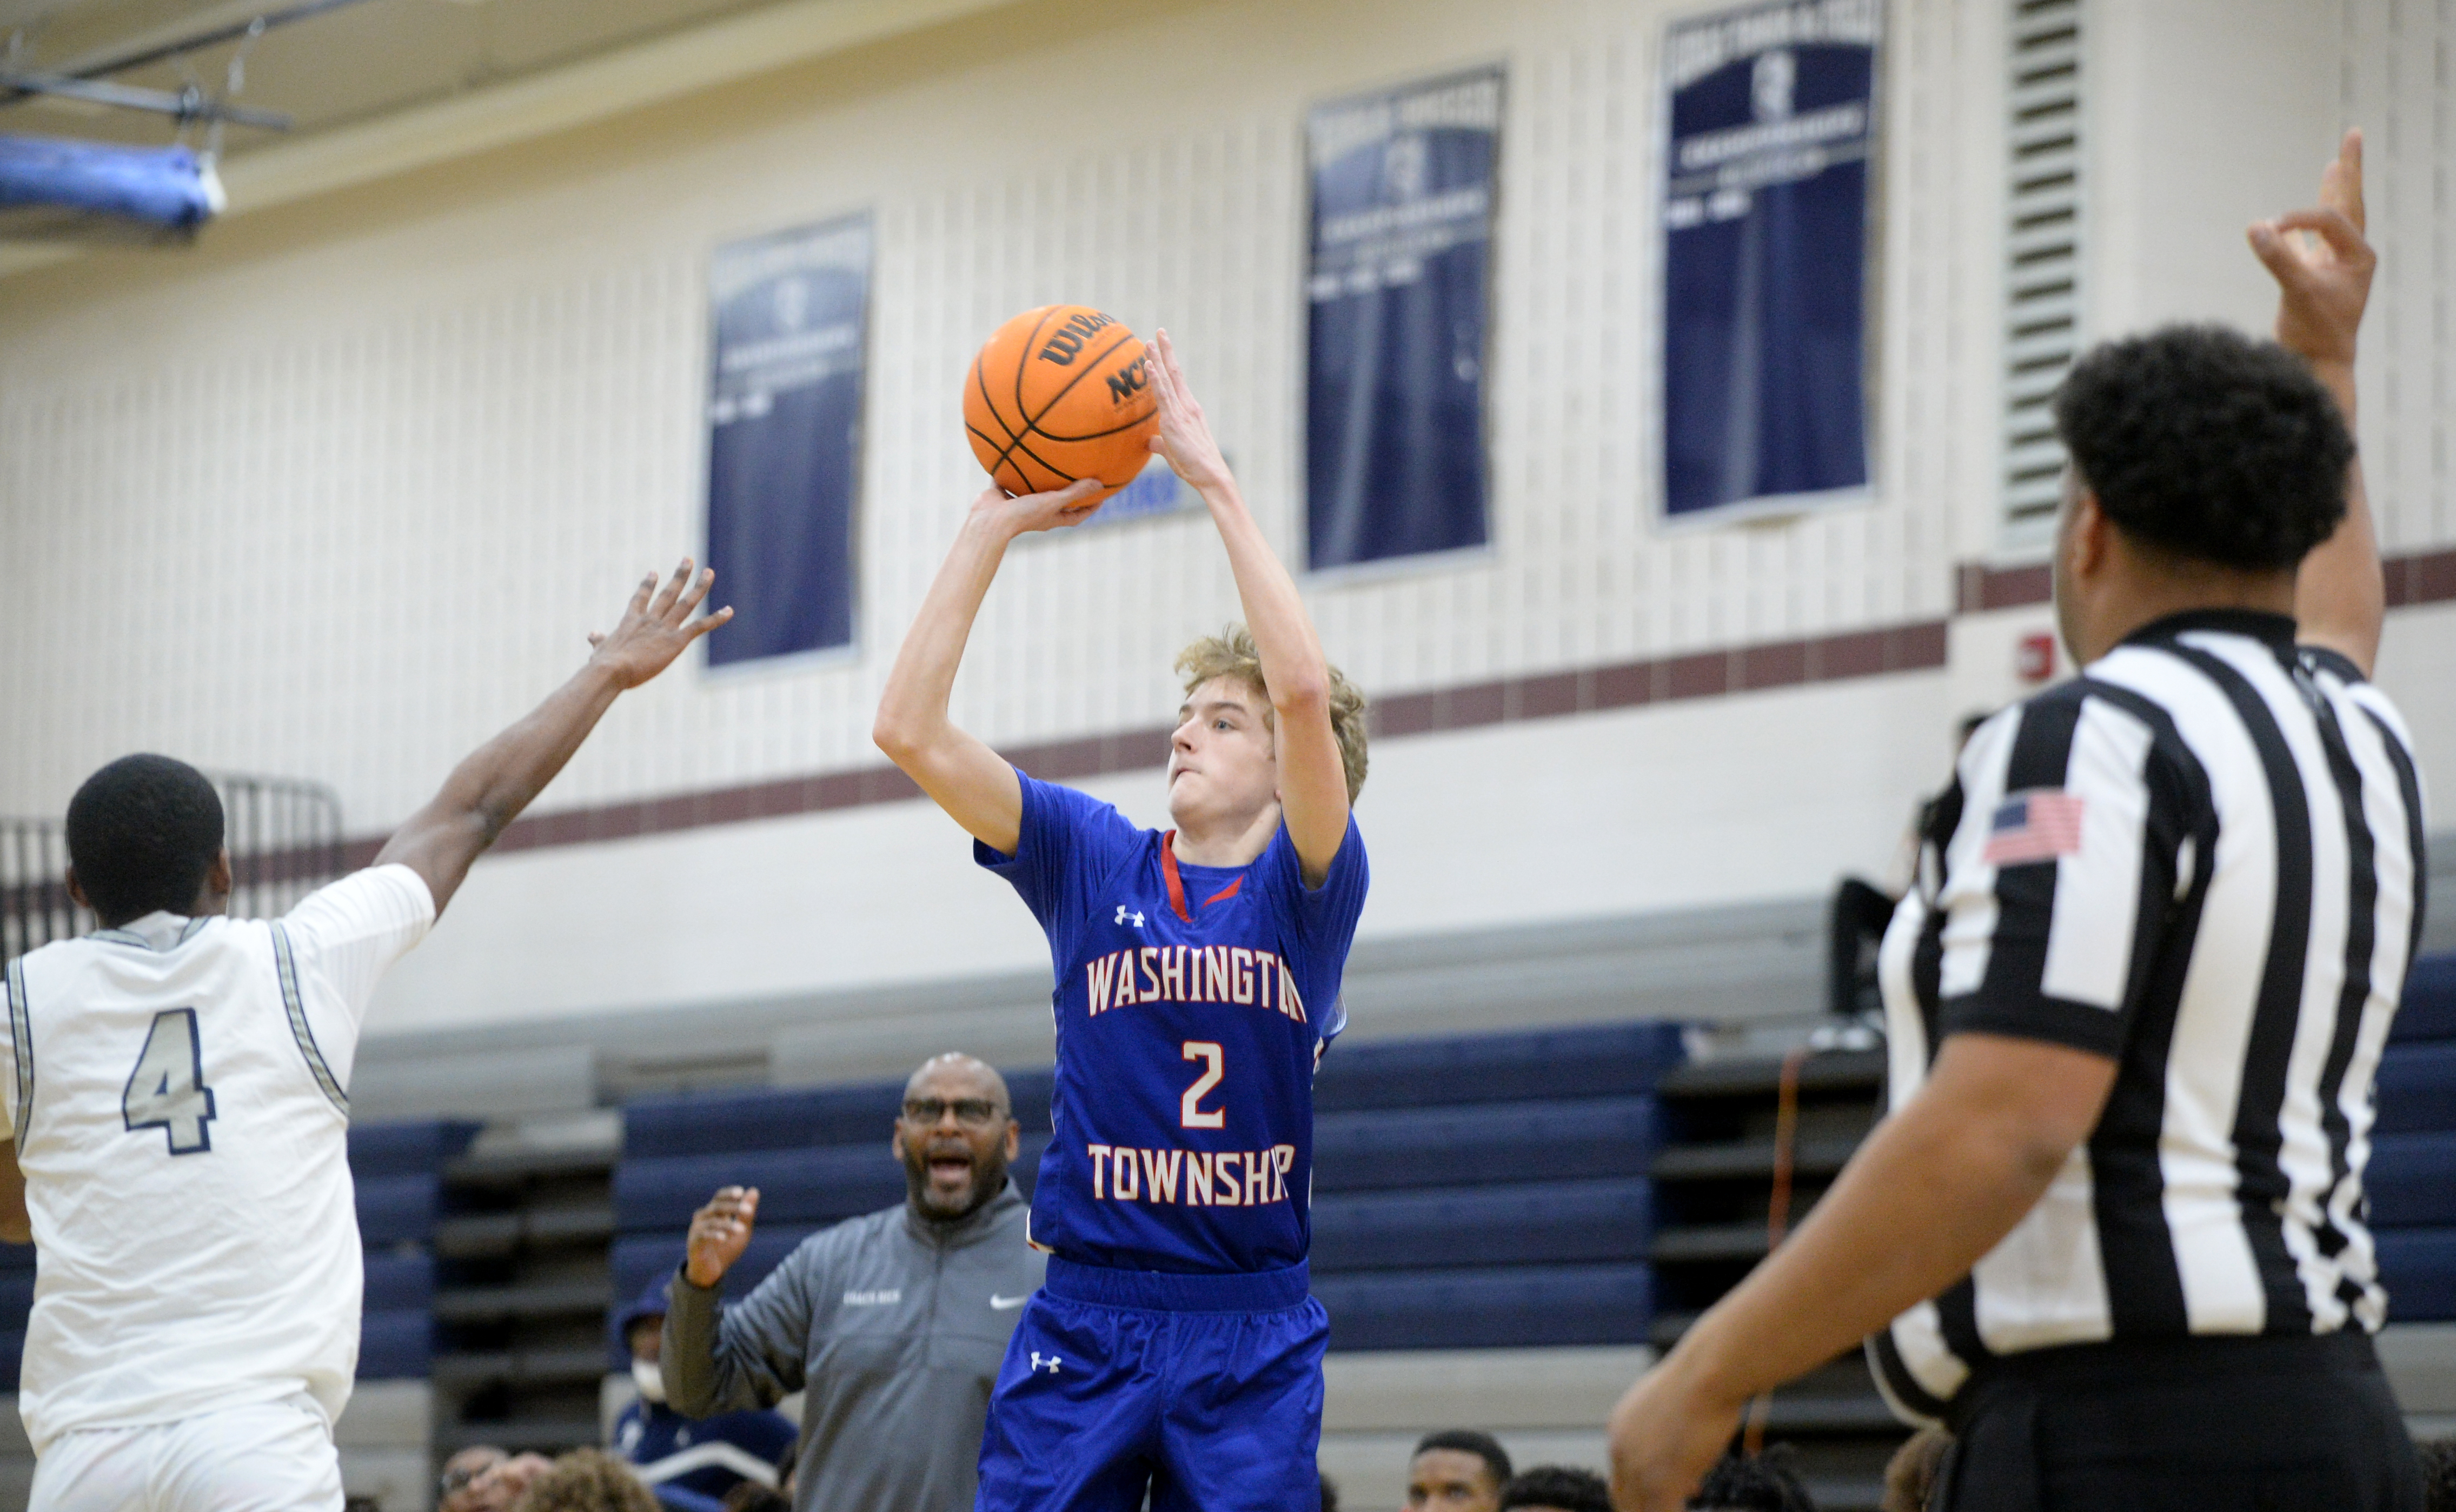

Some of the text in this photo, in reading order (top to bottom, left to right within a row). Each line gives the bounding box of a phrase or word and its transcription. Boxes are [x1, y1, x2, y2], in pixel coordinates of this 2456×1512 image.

[1039, 312, 1116, 366] Wilso
[121, 1007, 216, 1156] 4
[1180, 1040, 1226, 1130] 2
